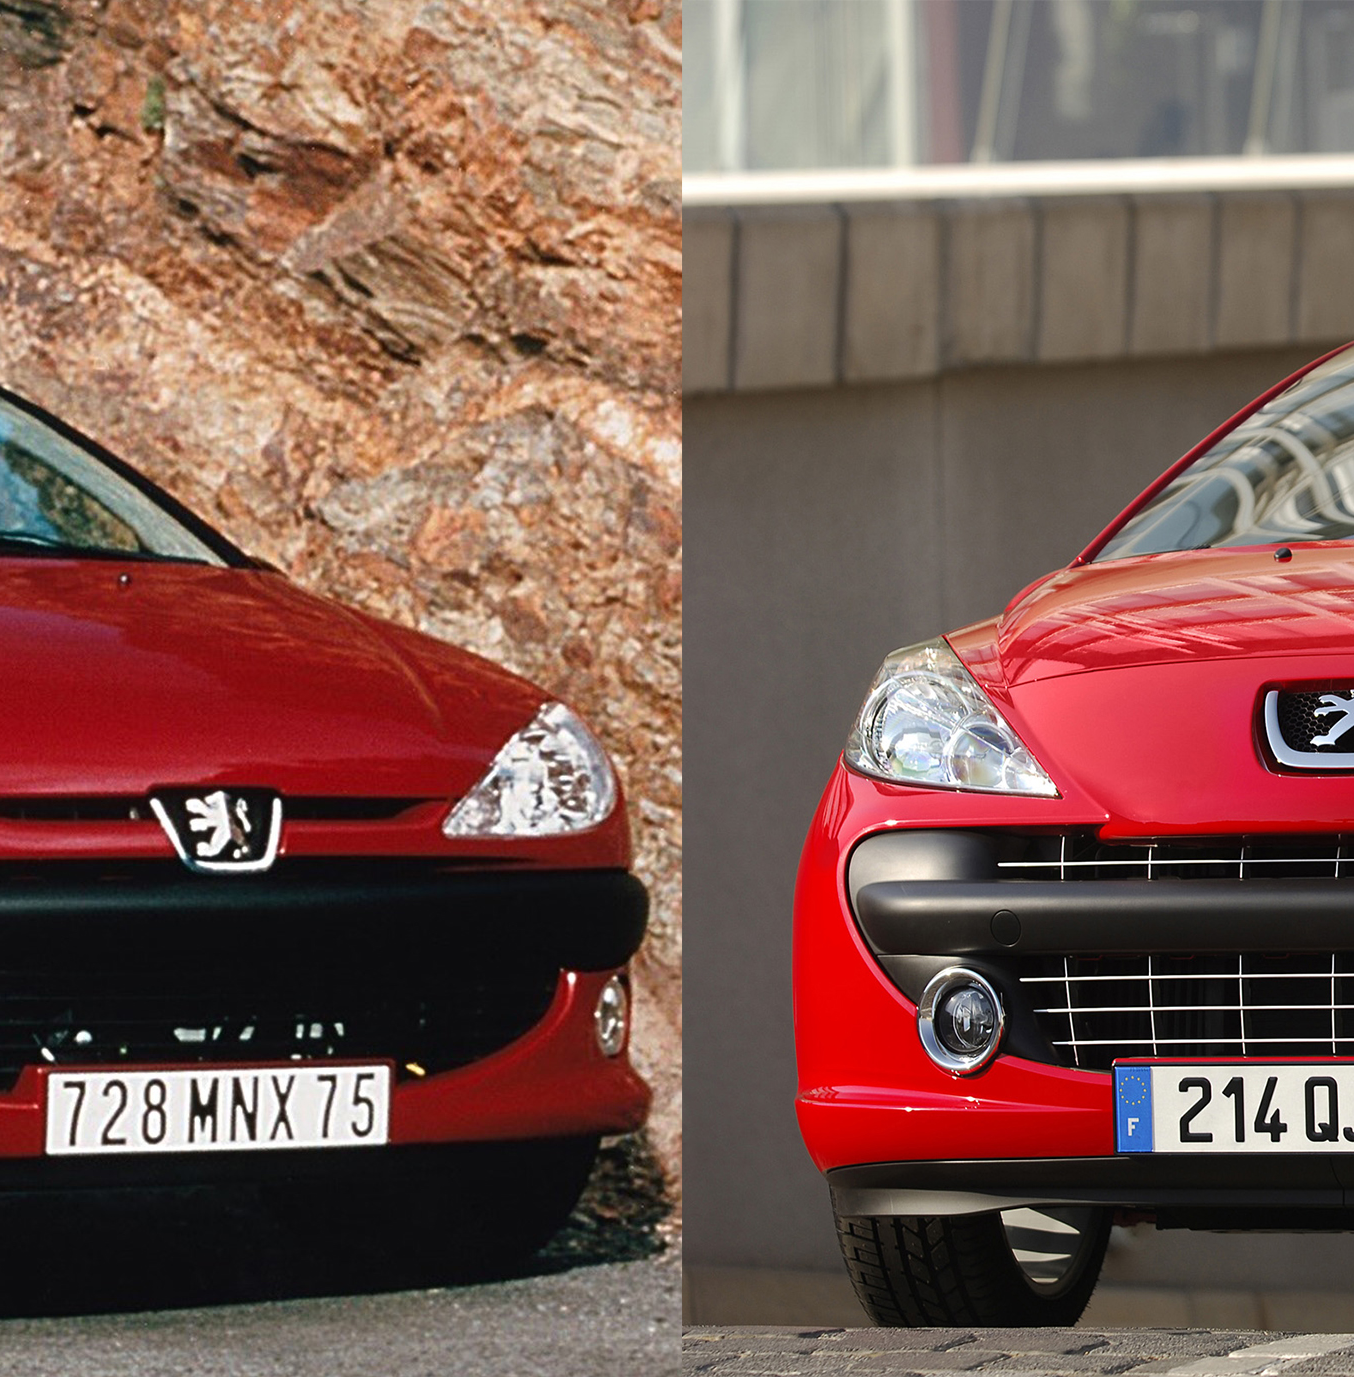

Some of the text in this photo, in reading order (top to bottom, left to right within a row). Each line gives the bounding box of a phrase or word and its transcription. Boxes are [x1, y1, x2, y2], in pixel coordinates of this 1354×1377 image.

[63, 1072, 375, 1146] 728 MNX 75
[1127, 1117, 1140, 1137] F
[1178, 1076, 1288, 1143] 214
